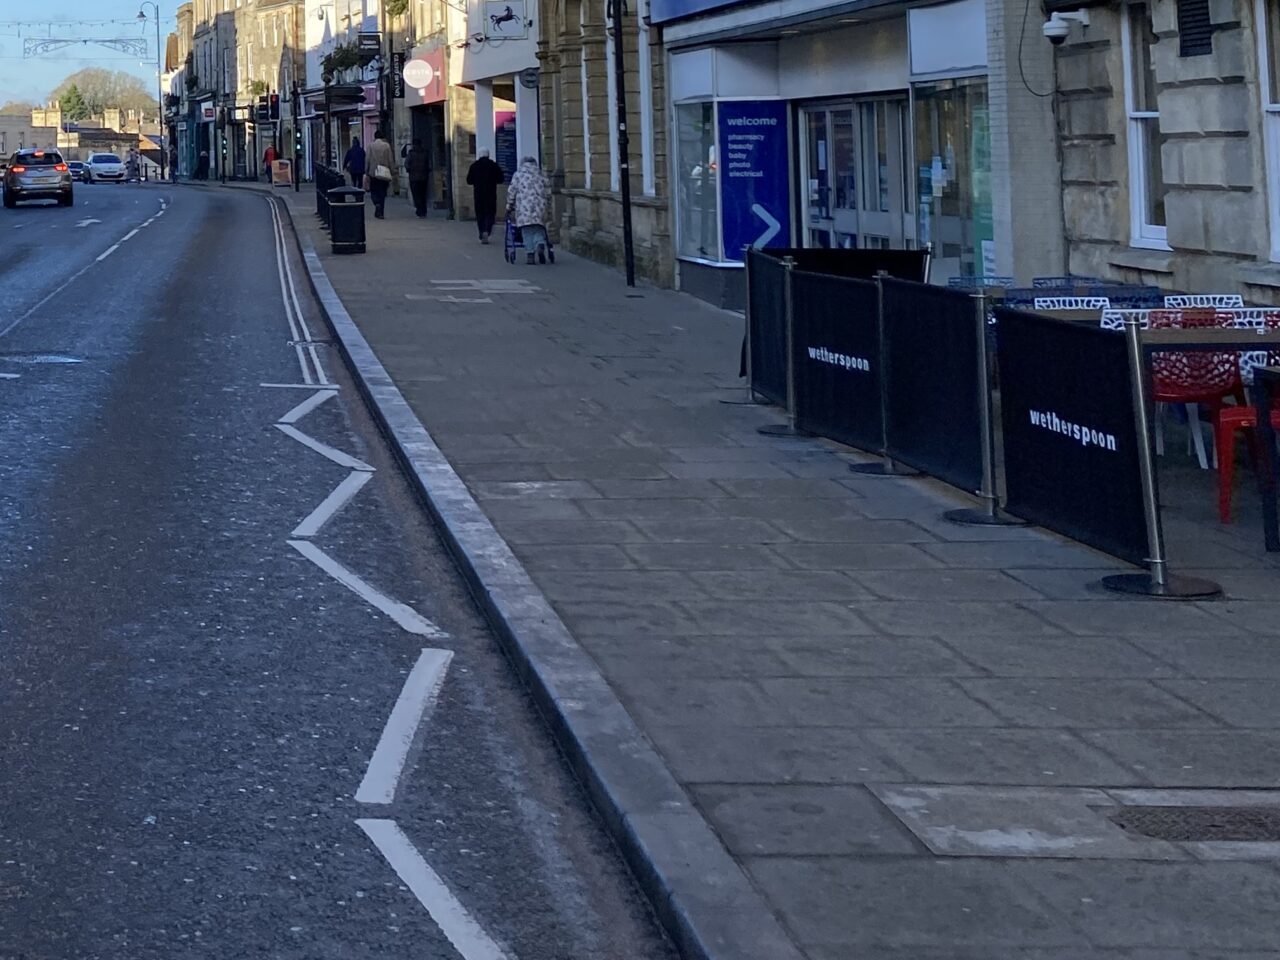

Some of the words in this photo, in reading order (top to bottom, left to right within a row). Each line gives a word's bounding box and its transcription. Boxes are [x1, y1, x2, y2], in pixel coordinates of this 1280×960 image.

[727, 116, 777, 126] welcome
[807, 346, 870, 371] wetherspoon
[1029, 409, 1117, 451] wetherspoon
